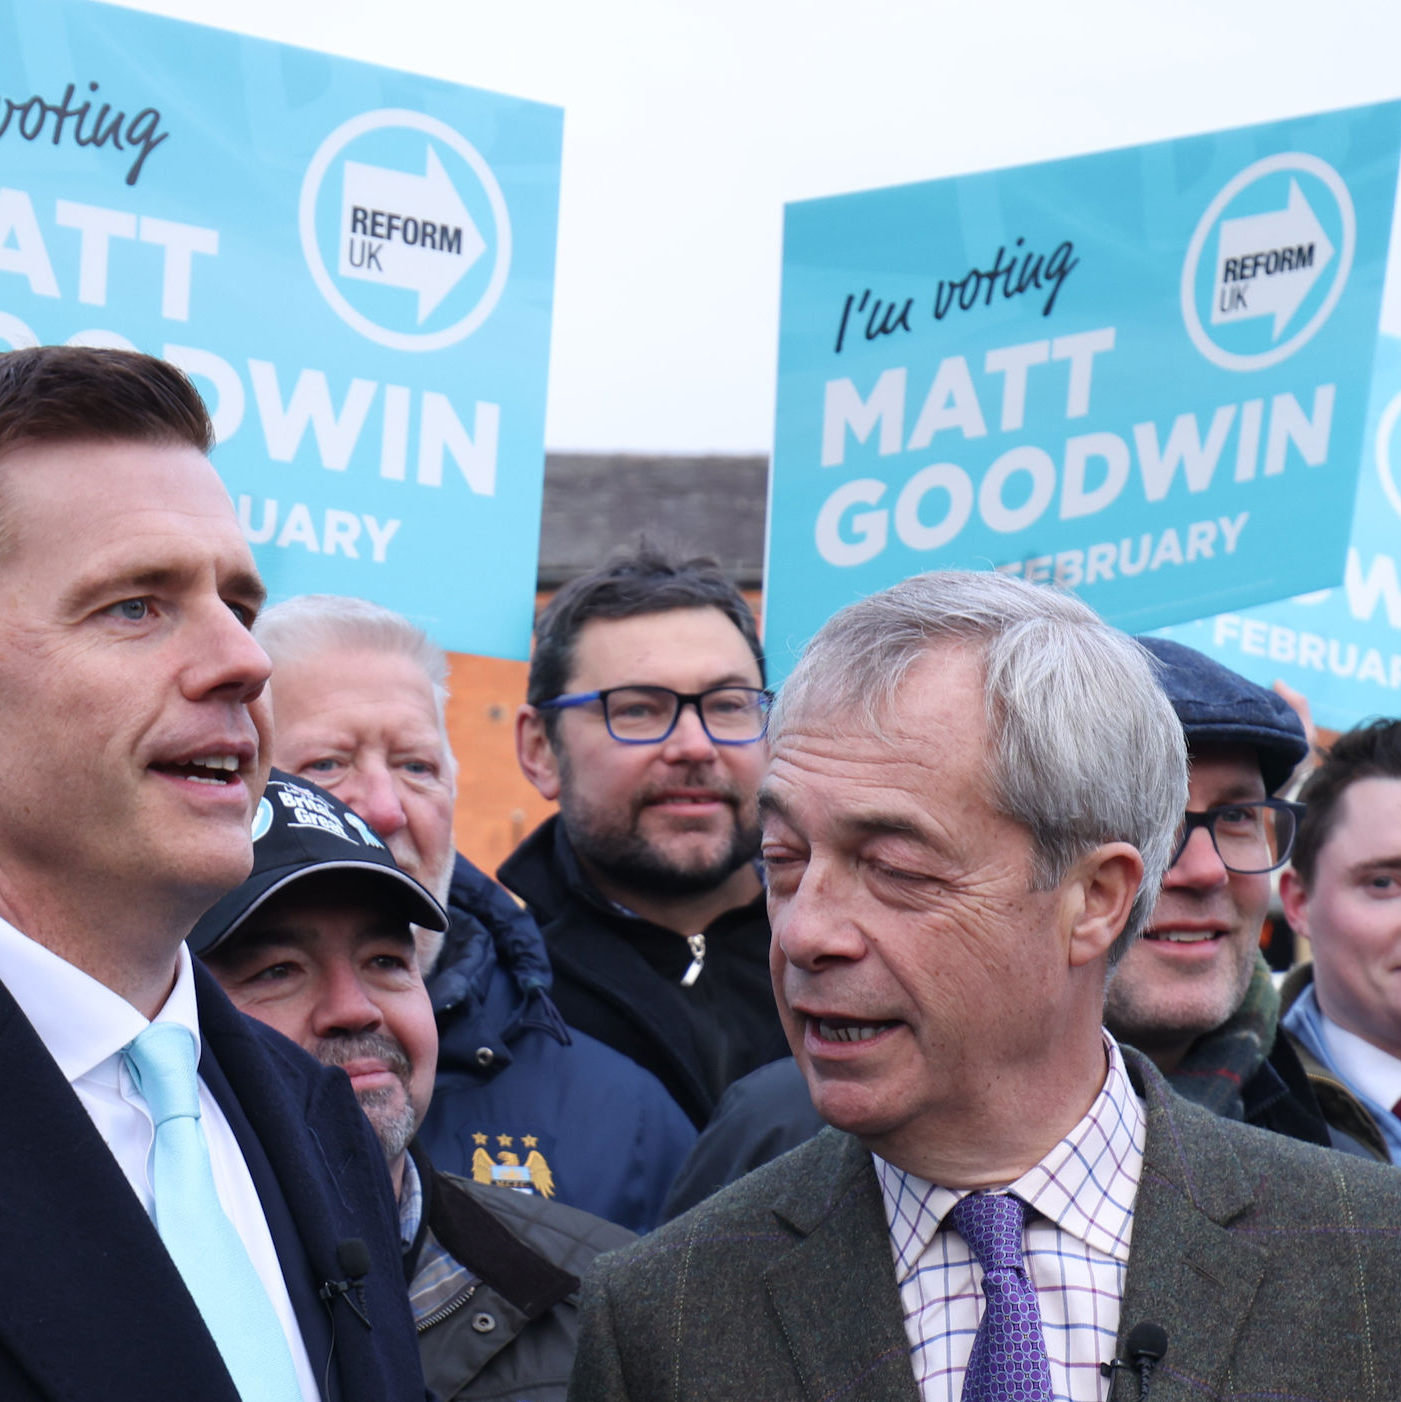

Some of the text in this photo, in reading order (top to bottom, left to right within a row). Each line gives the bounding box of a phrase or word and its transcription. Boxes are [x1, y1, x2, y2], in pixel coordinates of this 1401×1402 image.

[349, 237, 383, 272] UK
[352, 205, 462, 255] REFORM
[1223, 242, 1315, 283] REFORM
[834, 237, 1079, 353] I'm voting
[1220, 283, 1249, 312] UK
[821, 327, 1116, 467] MATT
[814, 384, 1336, 567] GOODWIN
